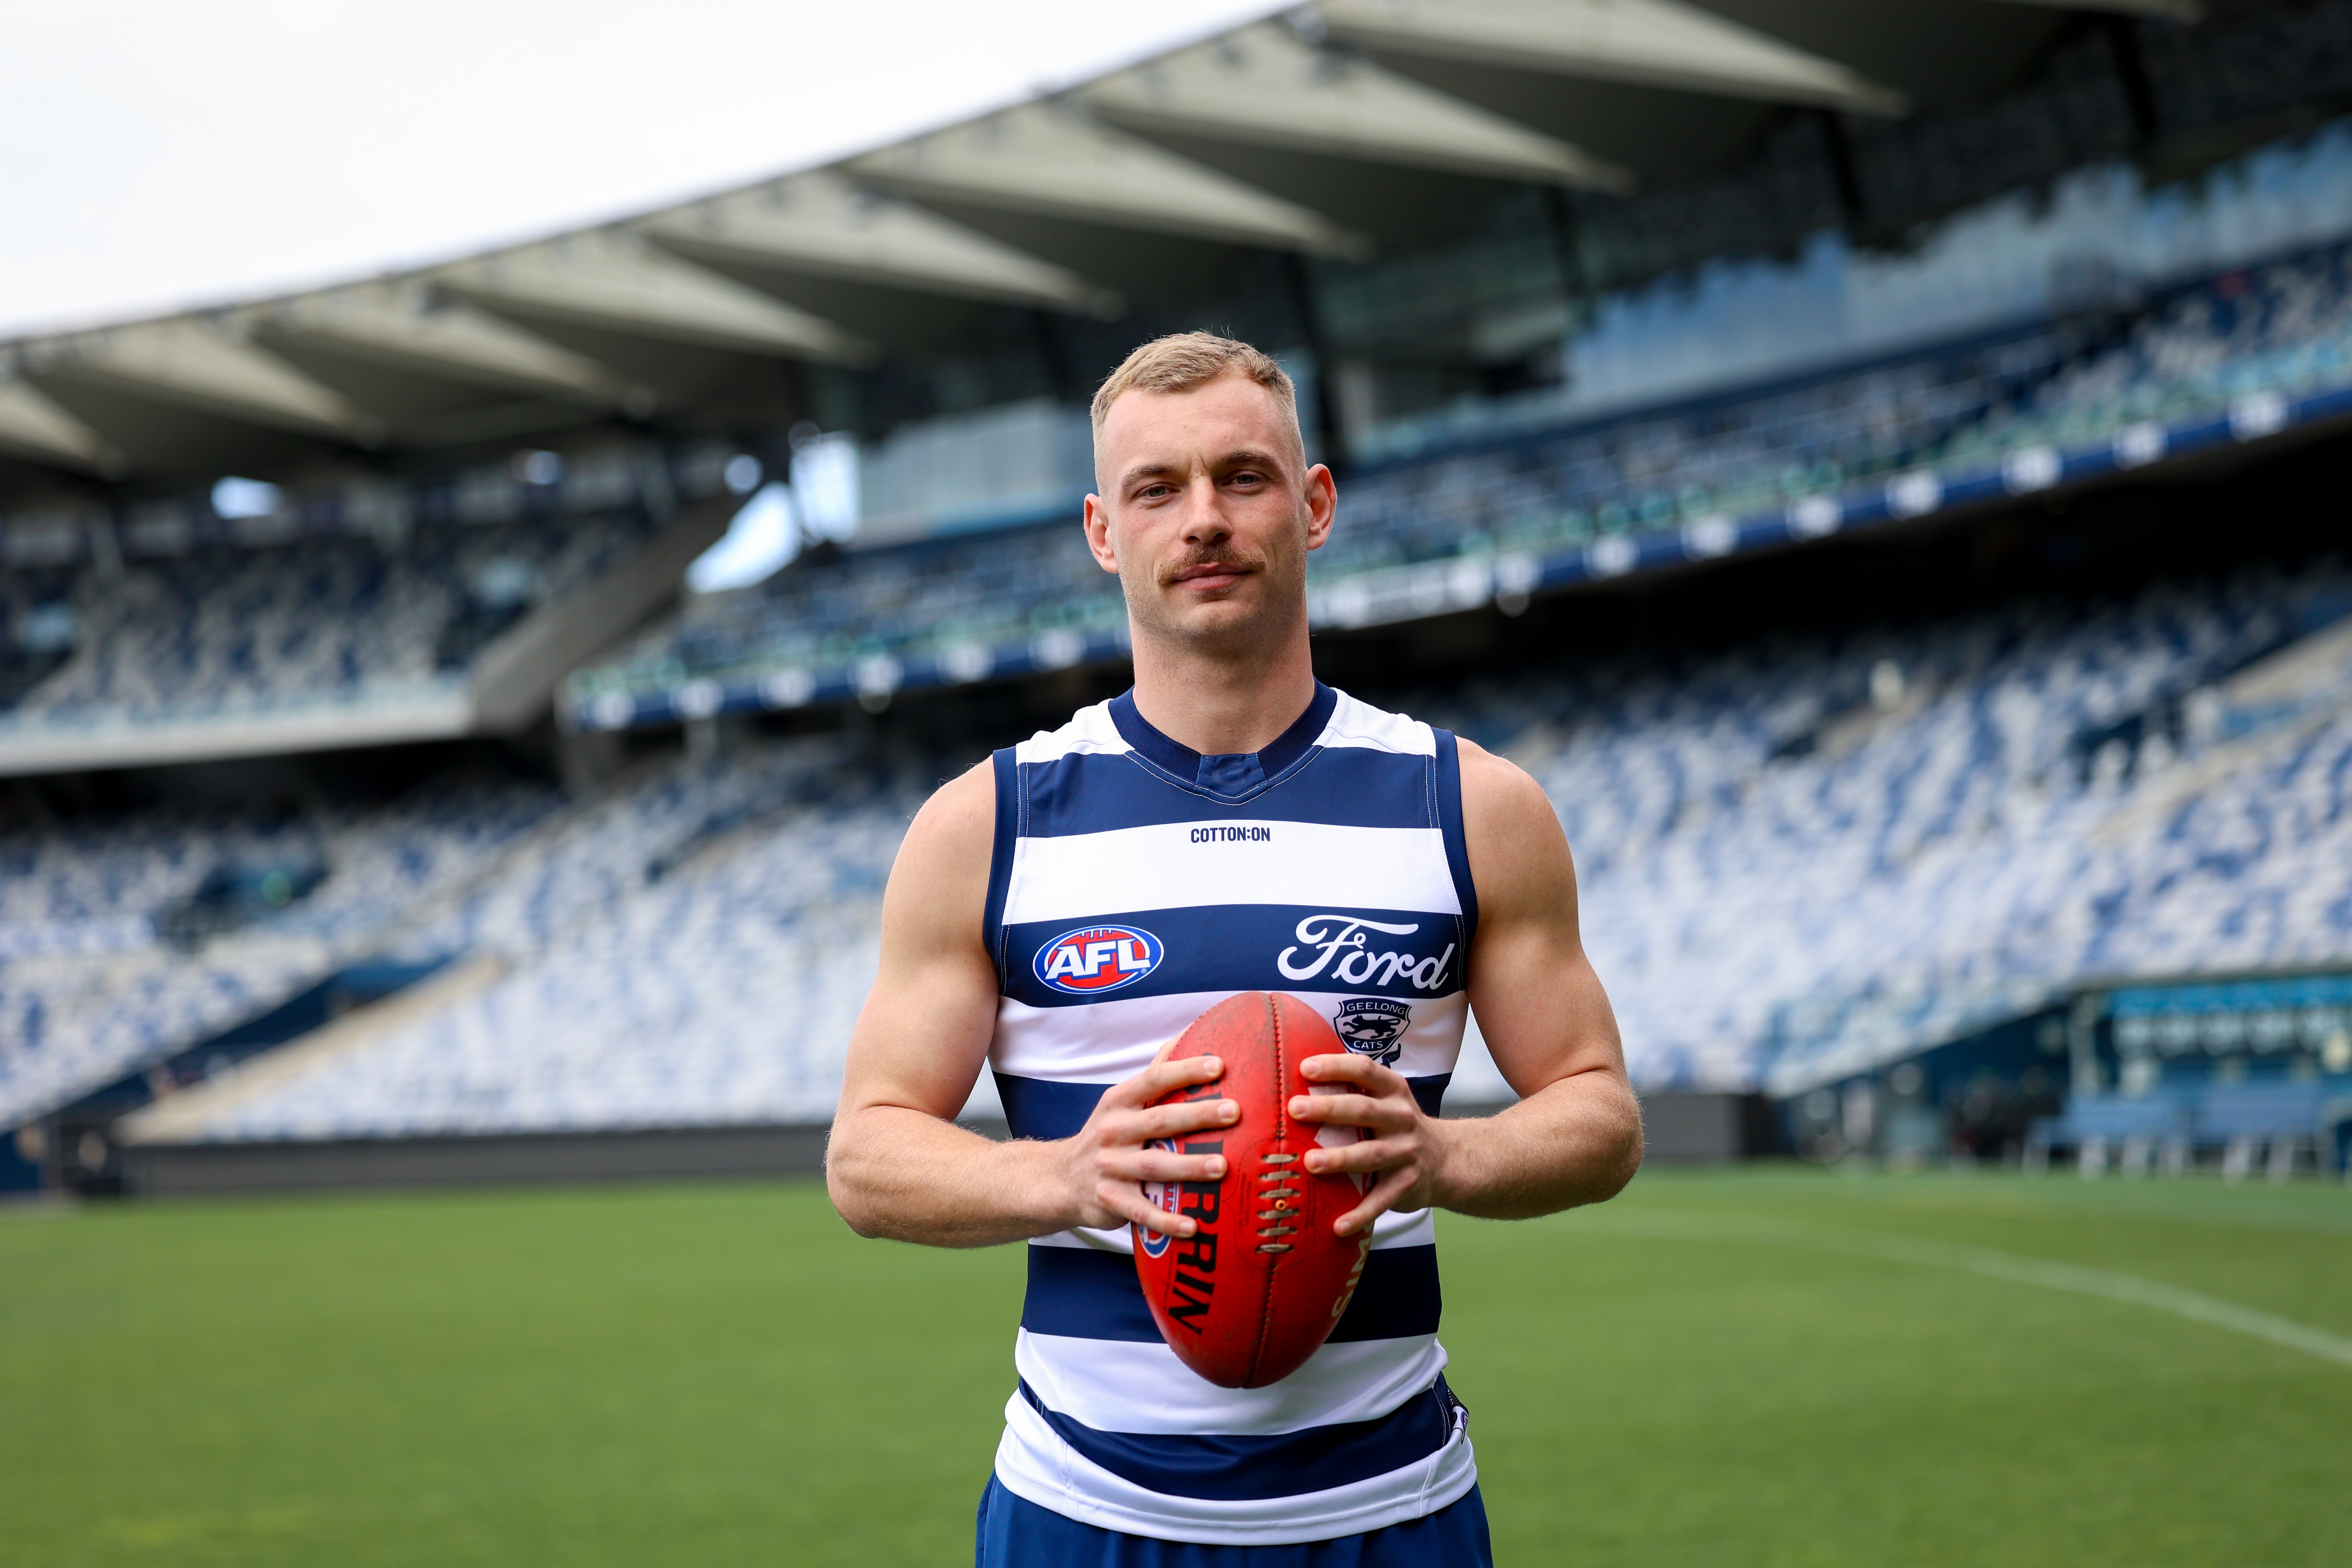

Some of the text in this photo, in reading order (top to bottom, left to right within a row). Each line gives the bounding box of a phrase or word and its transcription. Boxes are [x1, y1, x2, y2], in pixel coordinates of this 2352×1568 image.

[1191, 827, 1270, 843] COTTON:ON
[1045, 938, 1151, 980] AFL
[1277, 915, 1455, 990] Ford
[1346, 1002, 1406, 1015] GEELONG
[1353, 1040, 1383, 1049] CATS
